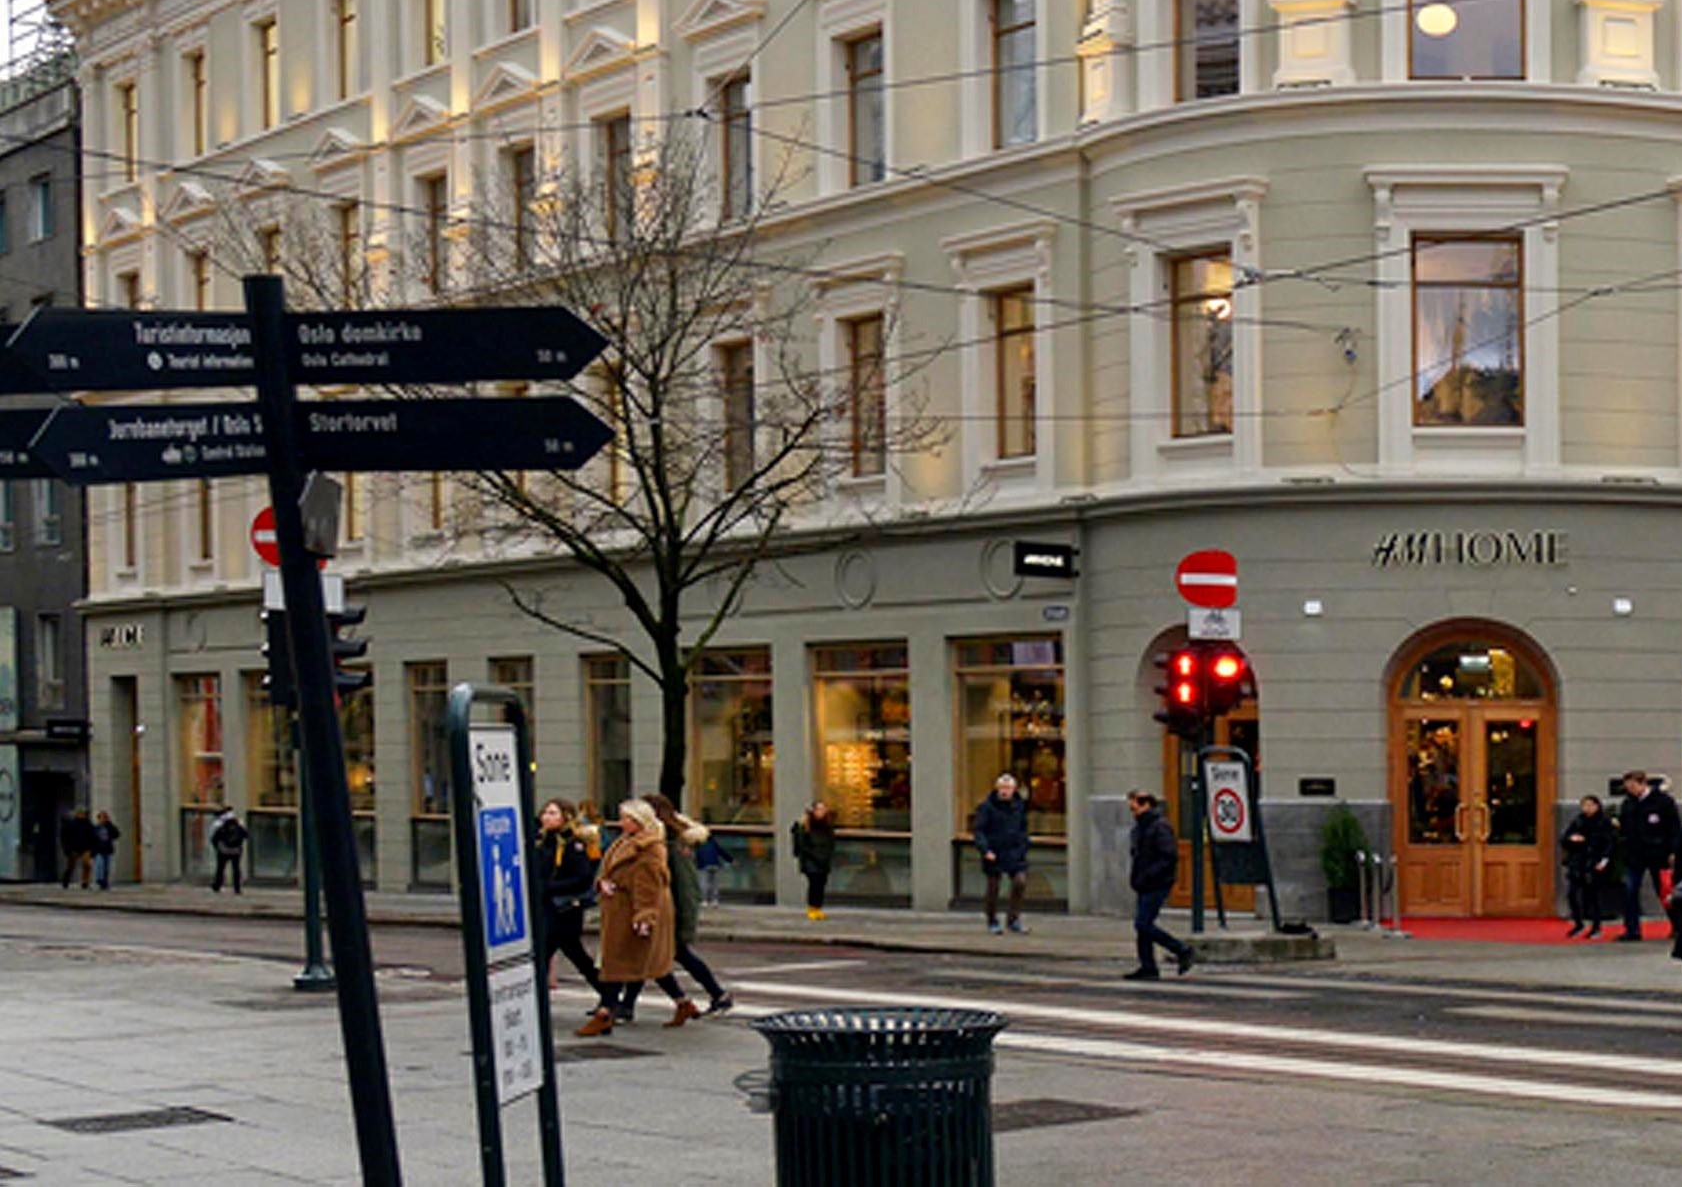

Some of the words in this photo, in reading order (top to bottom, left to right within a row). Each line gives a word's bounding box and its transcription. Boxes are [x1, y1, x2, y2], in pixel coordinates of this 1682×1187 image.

[298, 324, 335, 344] Oslo
[341, 321, 423, 343] domkirke
[309, 413, 398, 433] Stortorvet
[1434, 531, 1570, 565] HOME
[476, 742, 511, 783] Sone
